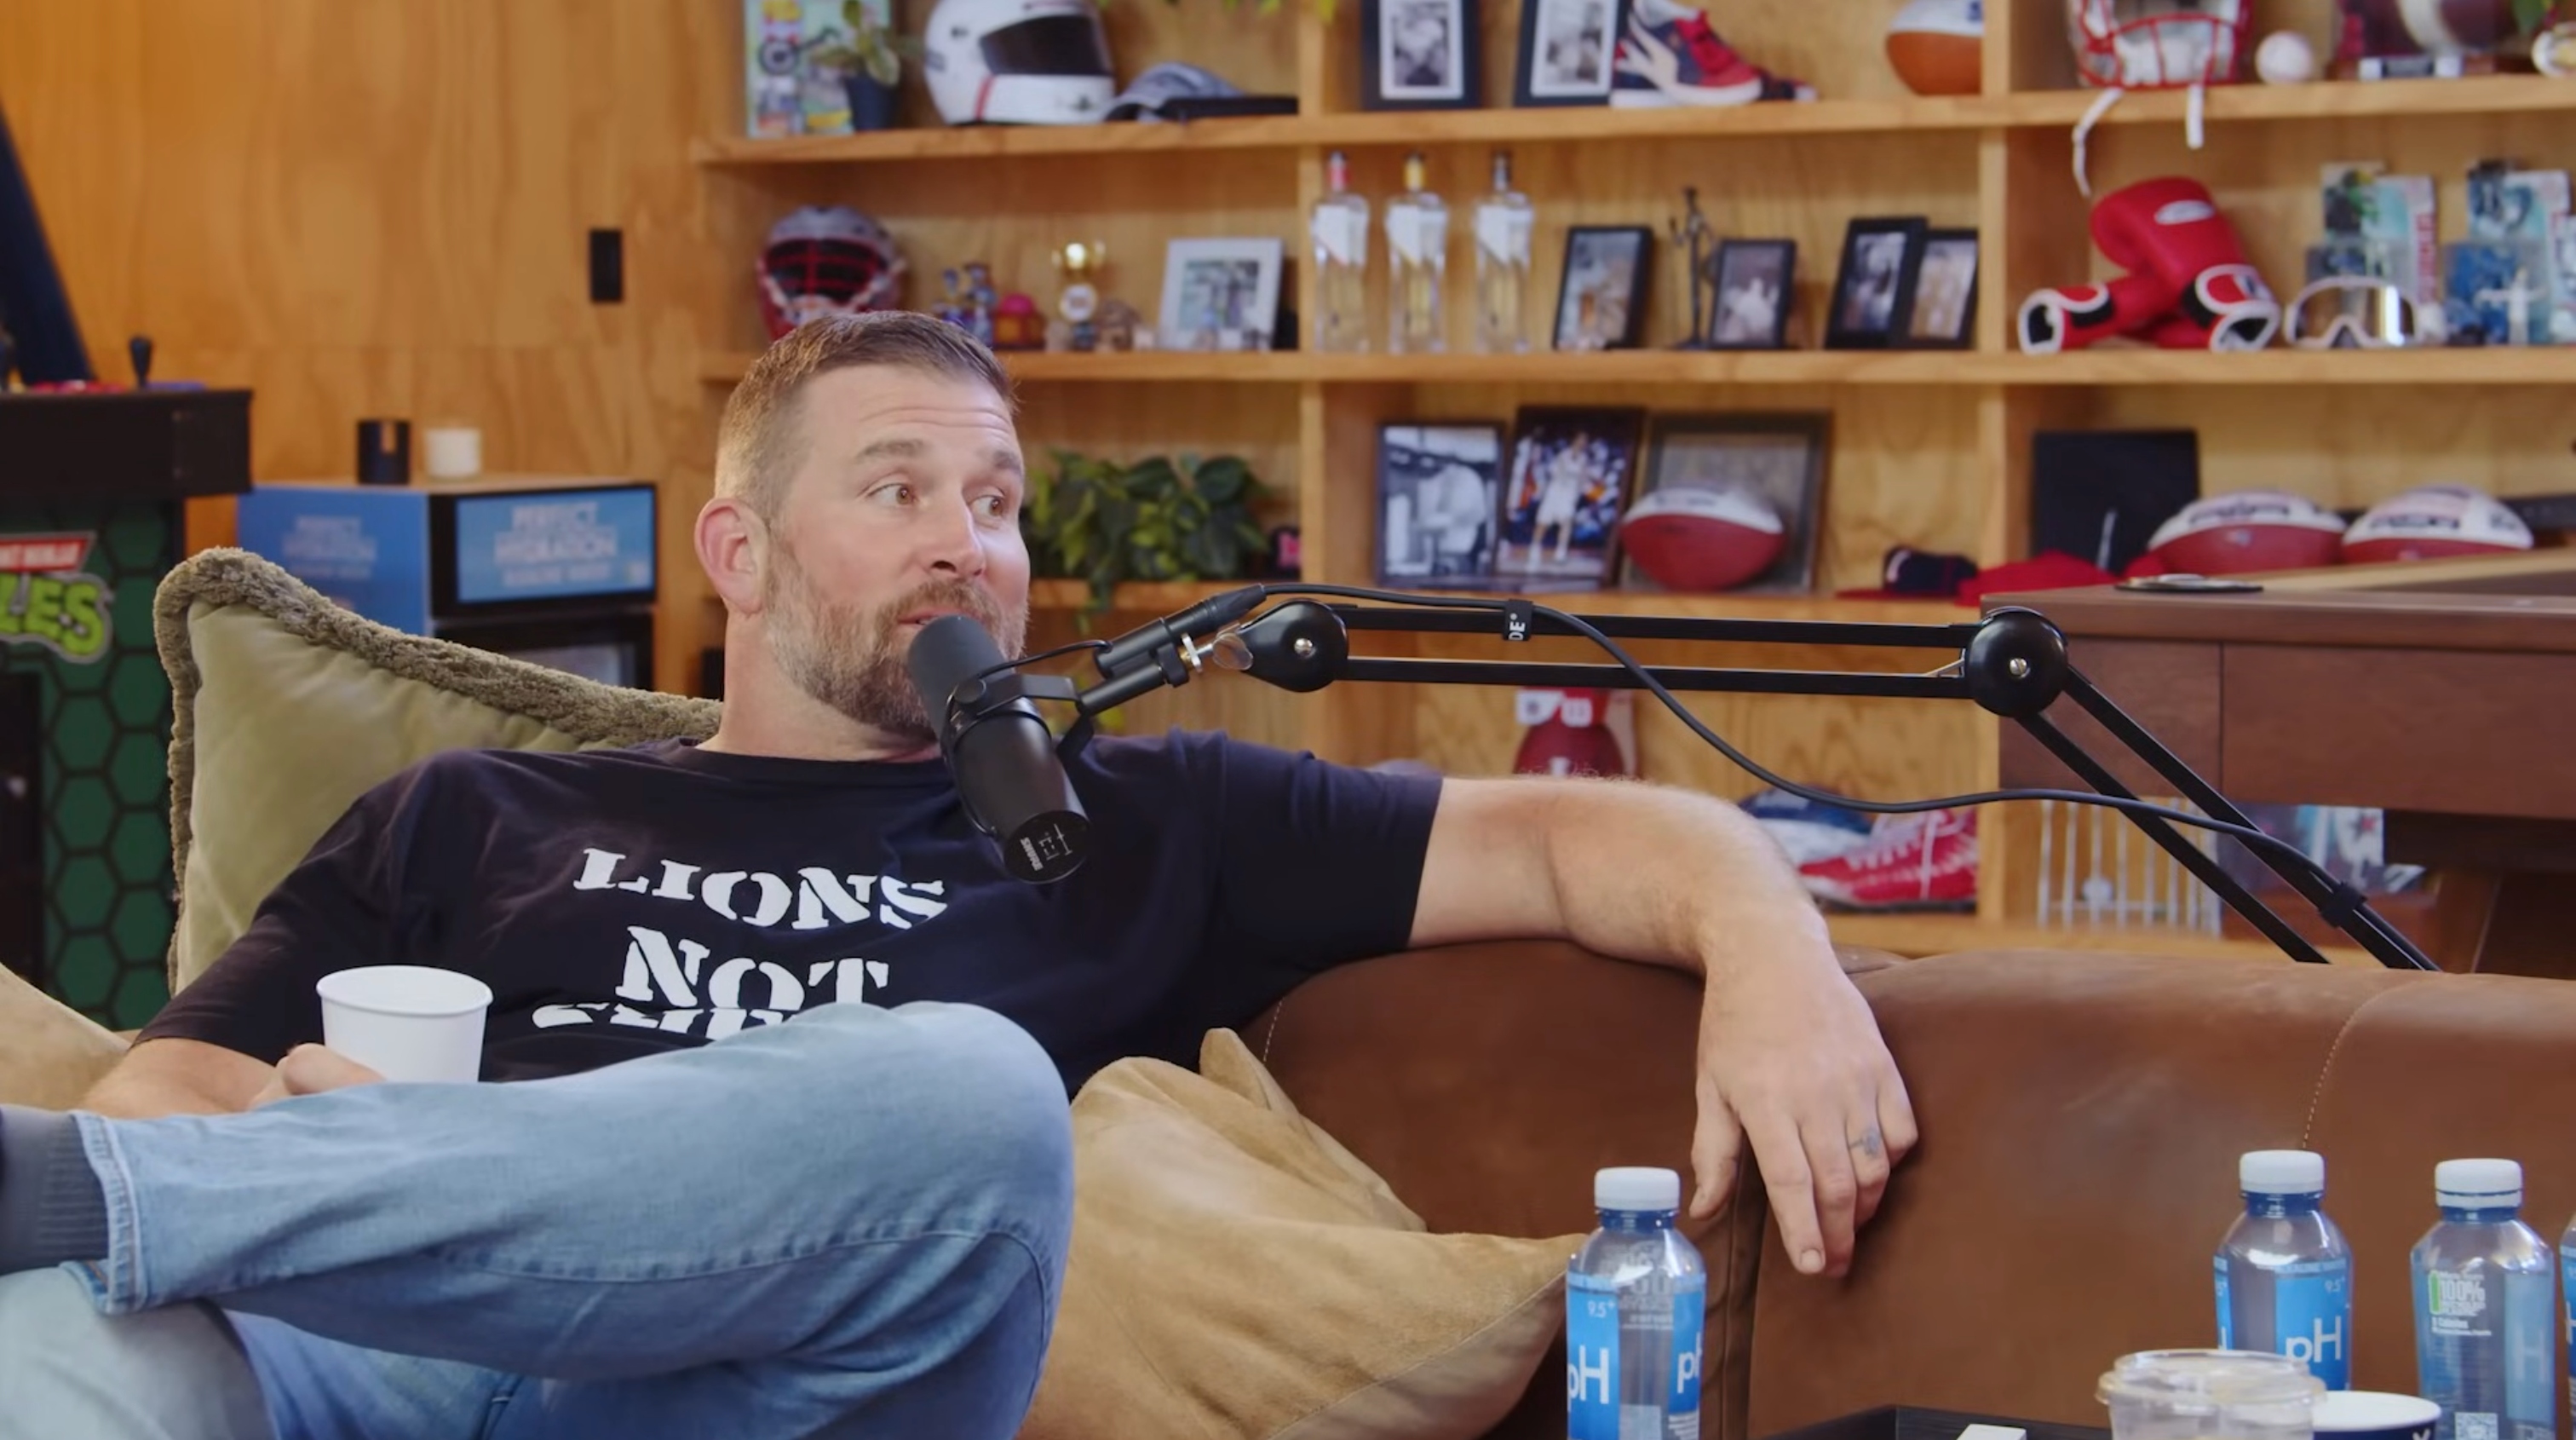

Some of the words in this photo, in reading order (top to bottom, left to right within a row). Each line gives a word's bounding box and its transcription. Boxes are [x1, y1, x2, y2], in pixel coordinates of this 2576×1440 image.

[1020, 837, 1044, 871] SHURE
[573, 848, 947, 930] LIONS
[615, 925, 888, 1009] NOT
[2441, 1280, 2486, 1302] 100%
[2286, 1316, 2342, 1364] pH
